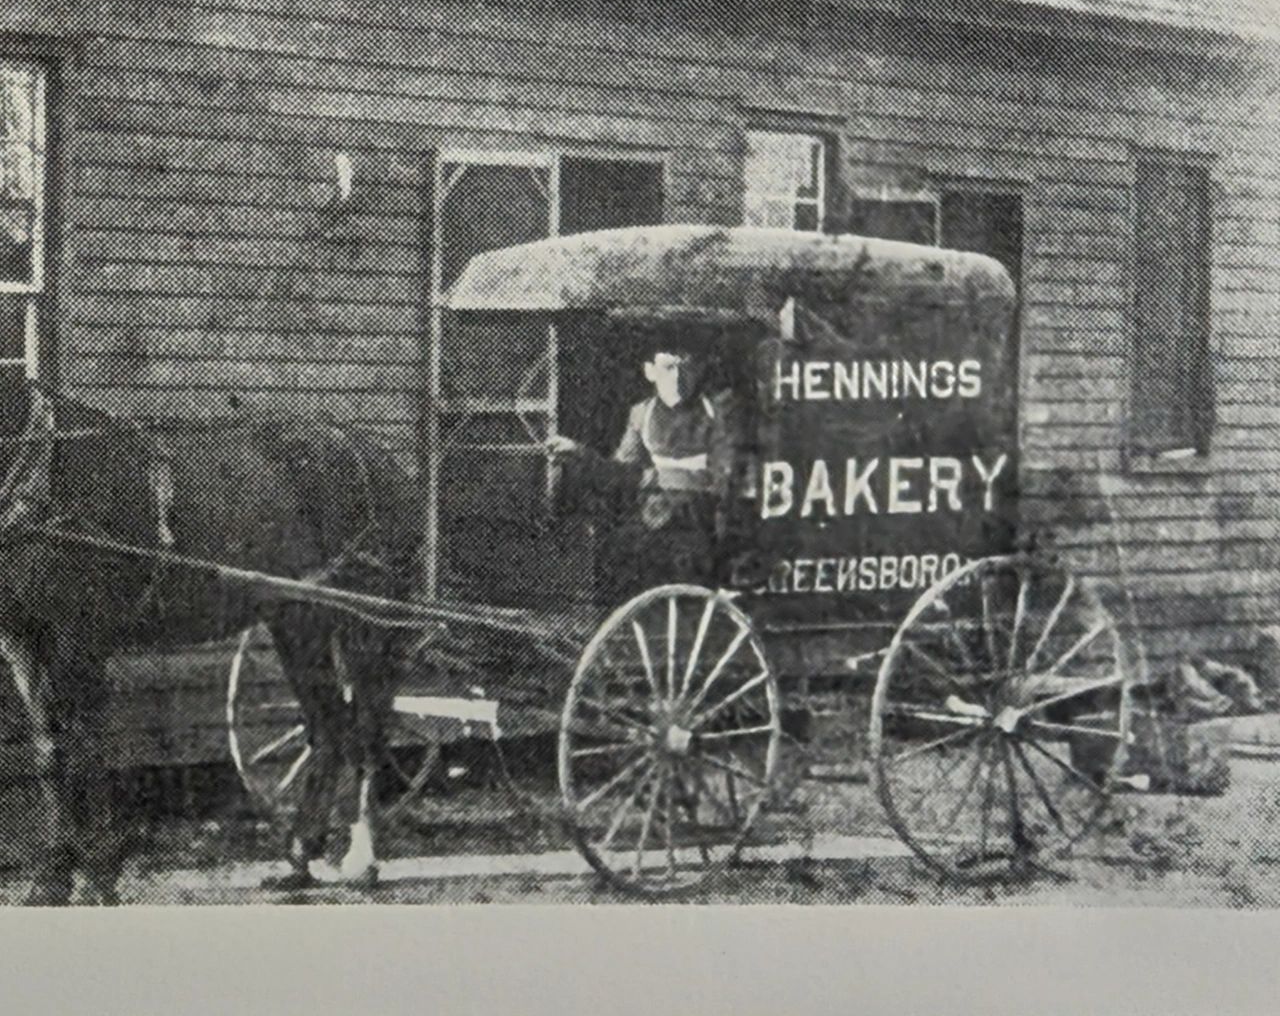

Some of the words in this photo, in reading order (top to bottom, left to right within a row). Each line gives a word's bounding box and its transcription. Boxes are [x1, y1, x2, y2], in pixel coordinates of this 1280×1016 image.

[774, 359, 982, 400] HENNINGS
[761, 453, 1007, 519] BAKERY
[751, 553, 961, 594] REENSBORO
